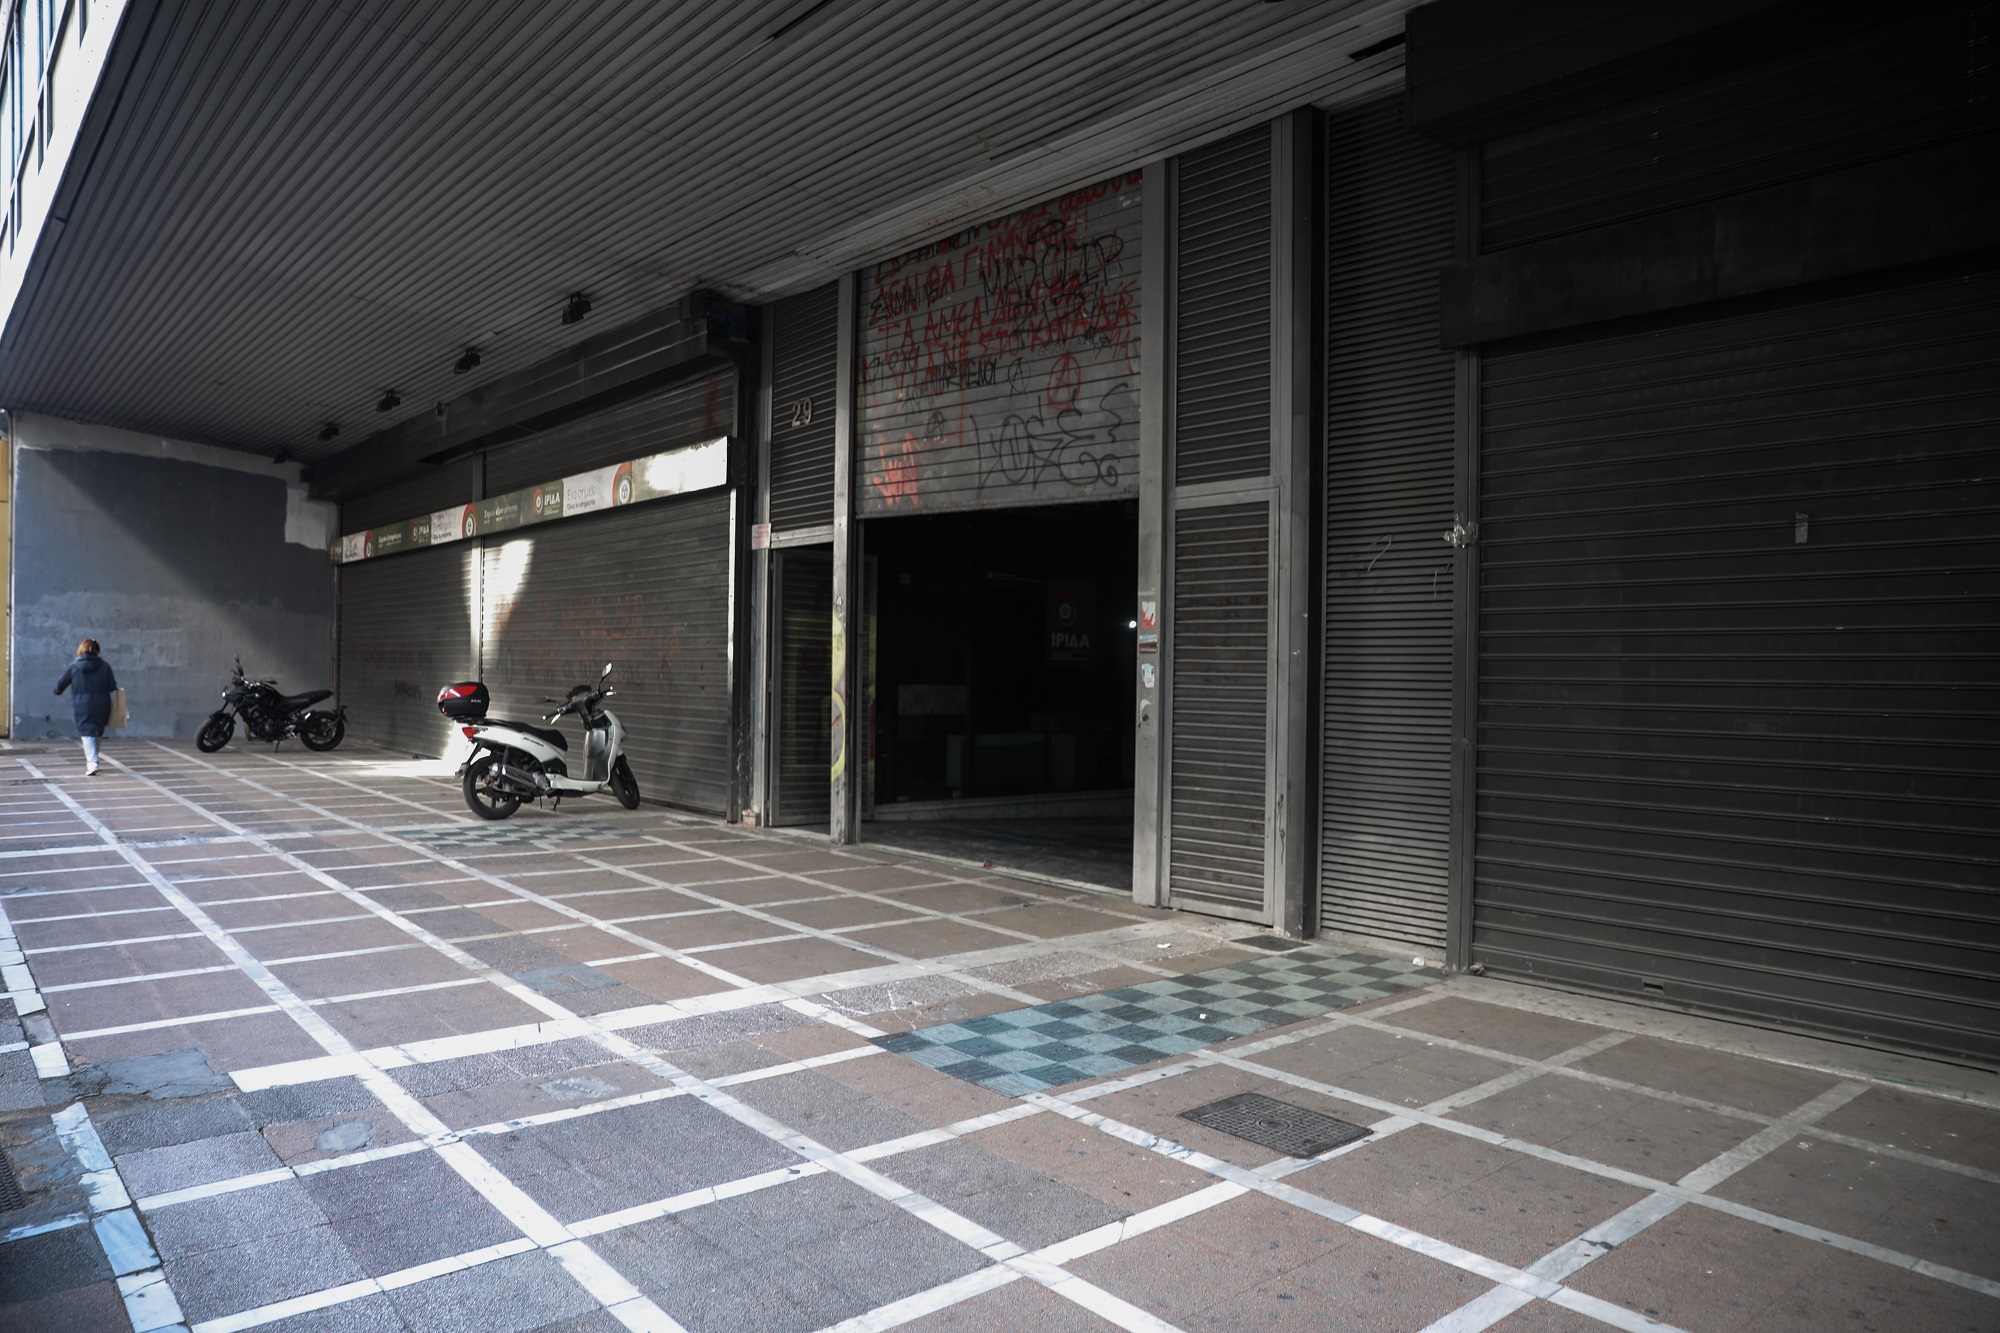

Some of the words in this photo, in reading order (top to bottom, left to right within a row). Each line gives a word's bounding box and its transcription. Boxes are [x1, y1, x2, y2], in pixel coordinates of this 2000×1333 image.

[791, 396, 813, 428] 29
[544, 492, 560, 506] ΙΡΙΔΑ
[1051, 632, 1090, 649] ΙΡΙΔΑ
